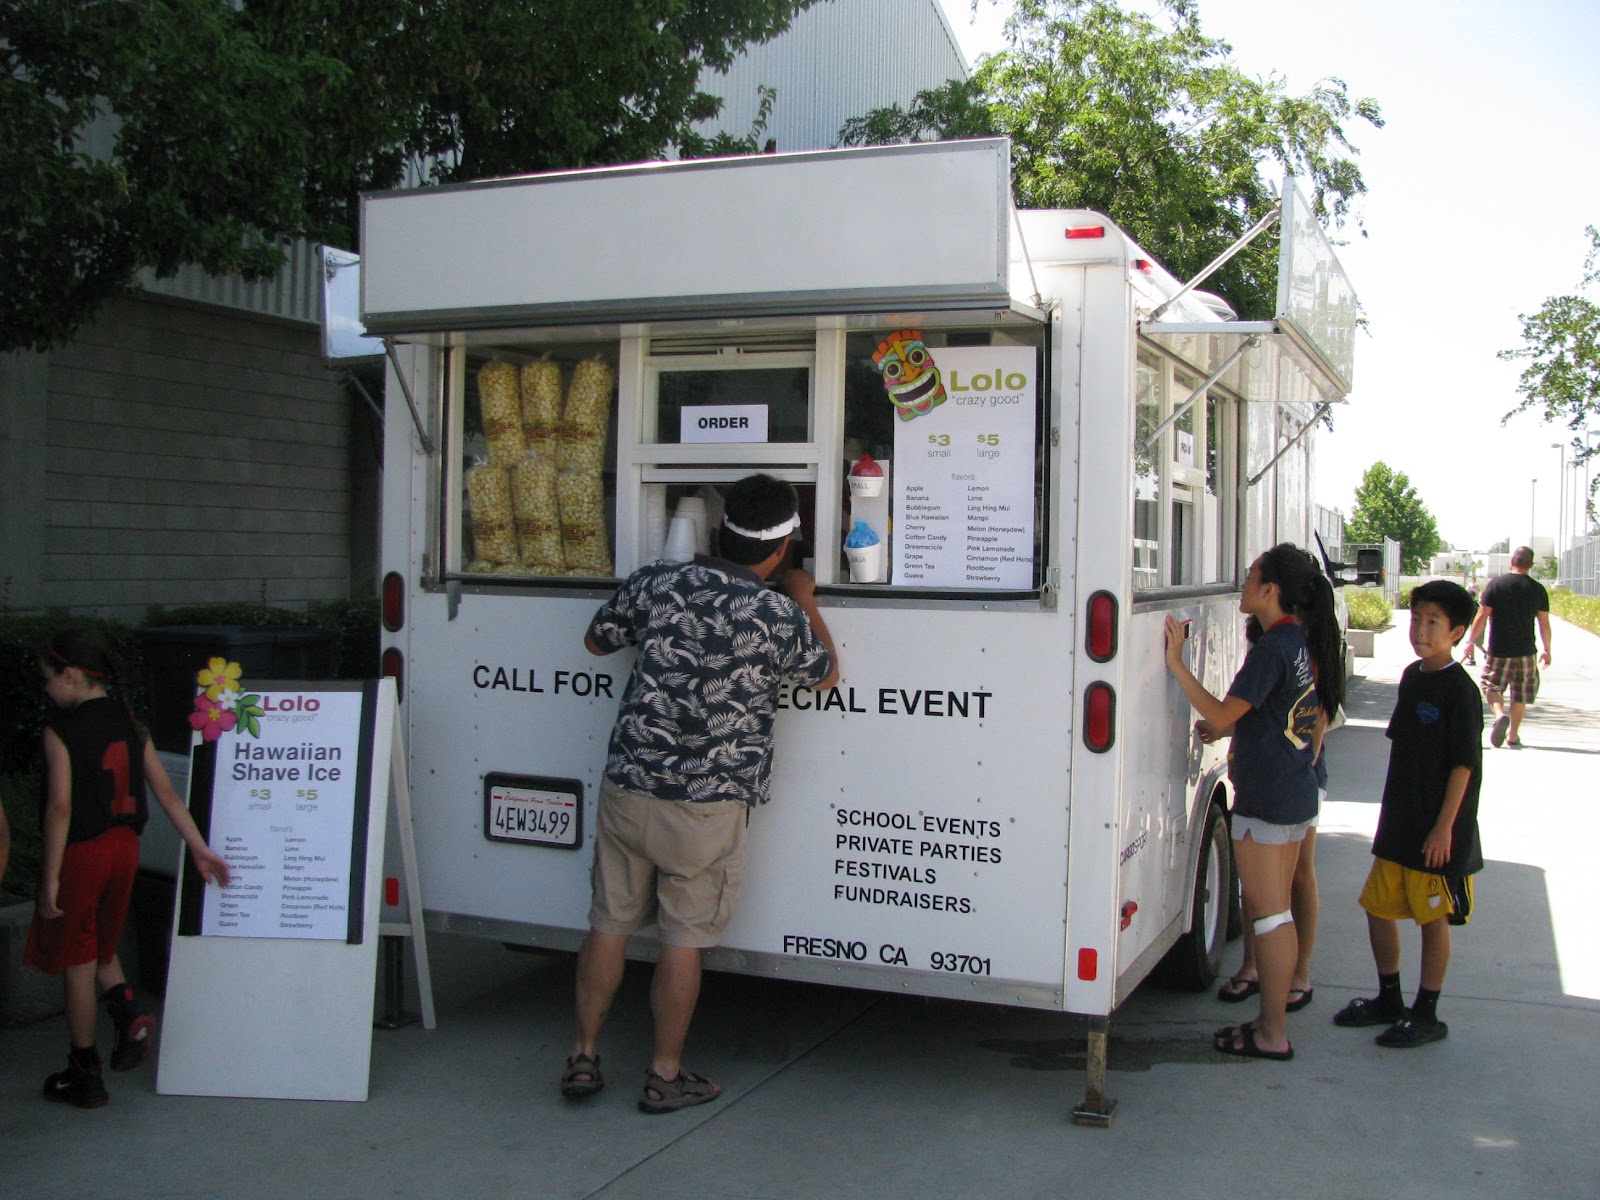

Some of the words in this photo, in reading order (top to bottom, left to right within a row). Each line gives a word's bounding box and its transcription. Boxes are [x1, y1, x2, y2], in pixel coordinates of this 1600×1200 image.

[950, 369, 1027, 392] Lolo
[698, 416, 749, 430] ORDER
[928, 434, 951, 447] $3
[977, 433, 1000, 447] $5
[927, 449, 951, 458] small
[976, 448, 1000, 459] large
[951, 473, 975, 481] flavors
[966, 574, 1000, 582] Strawberry
[473, 665, 544, 693] CALL
[554, 670, 614, 698] FOR
[777, 684, 866, 713] ECIAL
[878, 688, 993, 719] EVENT
[263, 695, 320, 712] Lolo
[235, 742, 342, 761] Hawaiian
[232, 763, 300, 781] Shave
[308, 763, 342, 781] Ice
[249, 788, 272, 801] $3
[296, 788, 319, 801] $5
[248, 803, 272, 811] small
[296, 802, 319, 812] large
[495, 806, 570, 835] 4EW3499
[836, 809, 917, 831] SCHOOL
[923, 816, 1001, 837] EVENTS
[836, 834, 913, 856] PRIVATE
[920, 841, 1002, 864] PARTIES
[835, 859, 937, 884] FESTIVALS
[834, 885, 971, 914] FUNDRAISERS
[783, 935, 867, 960] FRESNO
[879, 944, 909, 966] CA
[930, 952, 992, 976] 93701
